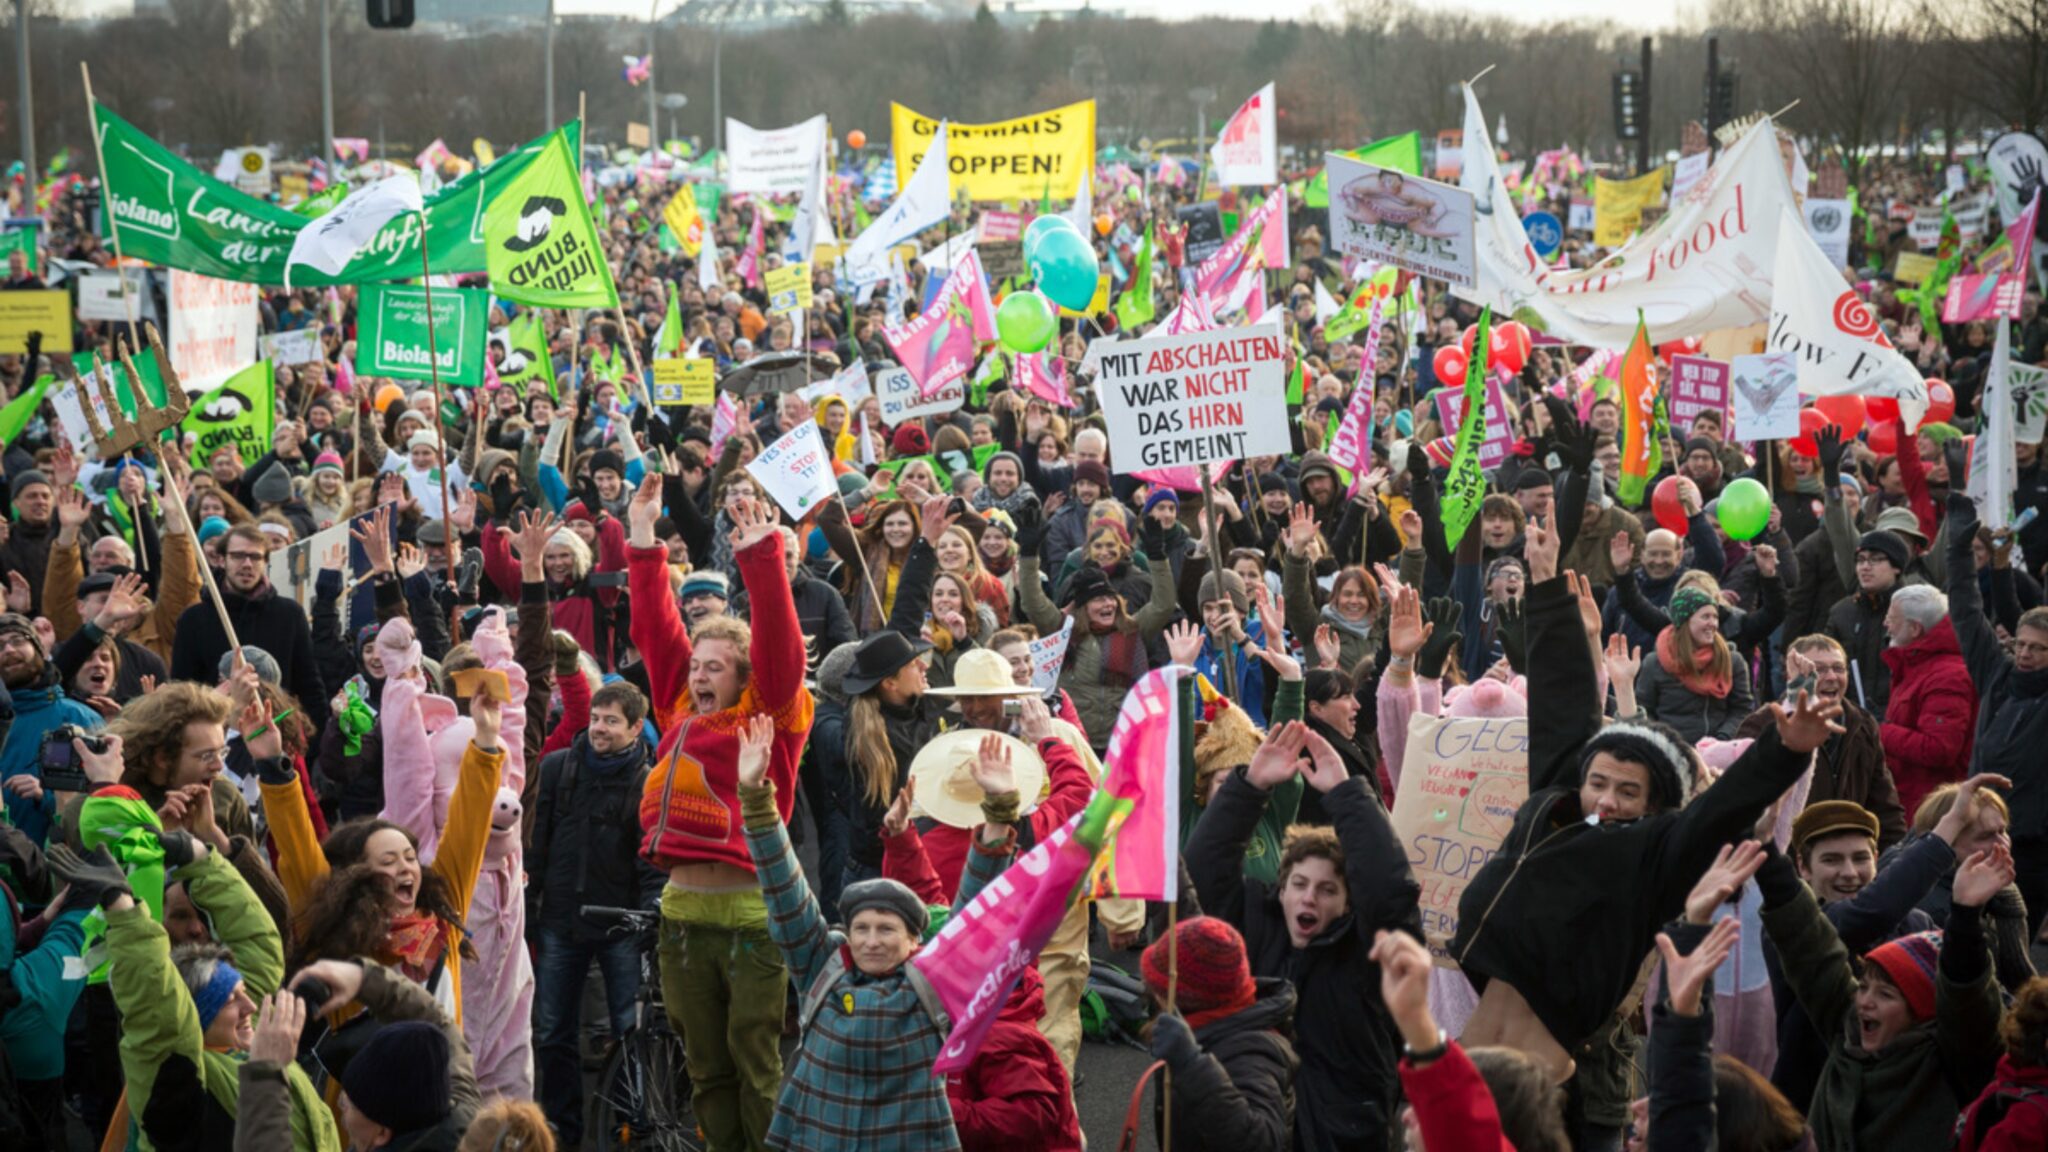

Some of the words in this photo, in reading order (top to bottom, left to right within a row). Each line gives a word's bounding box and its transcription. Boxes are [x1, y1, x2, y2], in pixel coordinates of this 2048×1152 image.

[911, 153, 1062, 175] SOPPEN!
[111, 194, 172, 230] ioland
[1646, 183, 1749, 282] Food
[383, 340, 455, 367] Bioland
[1772, 312, 1836, 365] low
[1101, 353, 1142, 379] MIT
[1146, 336, 1286, 374] ABSCHALTEN,
[887, 373, 910, 393] ISS
[1121, 378, 1179, 407] WAR
[1184, 368, 1251, 398] NICHT
[1138, 409, 1183, 436] DAS
[1188, 402, 1244, 430] HIRN
[759, 447, 780, 465] YES
[778, 436, 796, 450] WE
[1141, 432, 1247, 467] GEMEINT
[1042, 636, 1061, 649] WE
[1434, 718, 1529, 759] GEG
